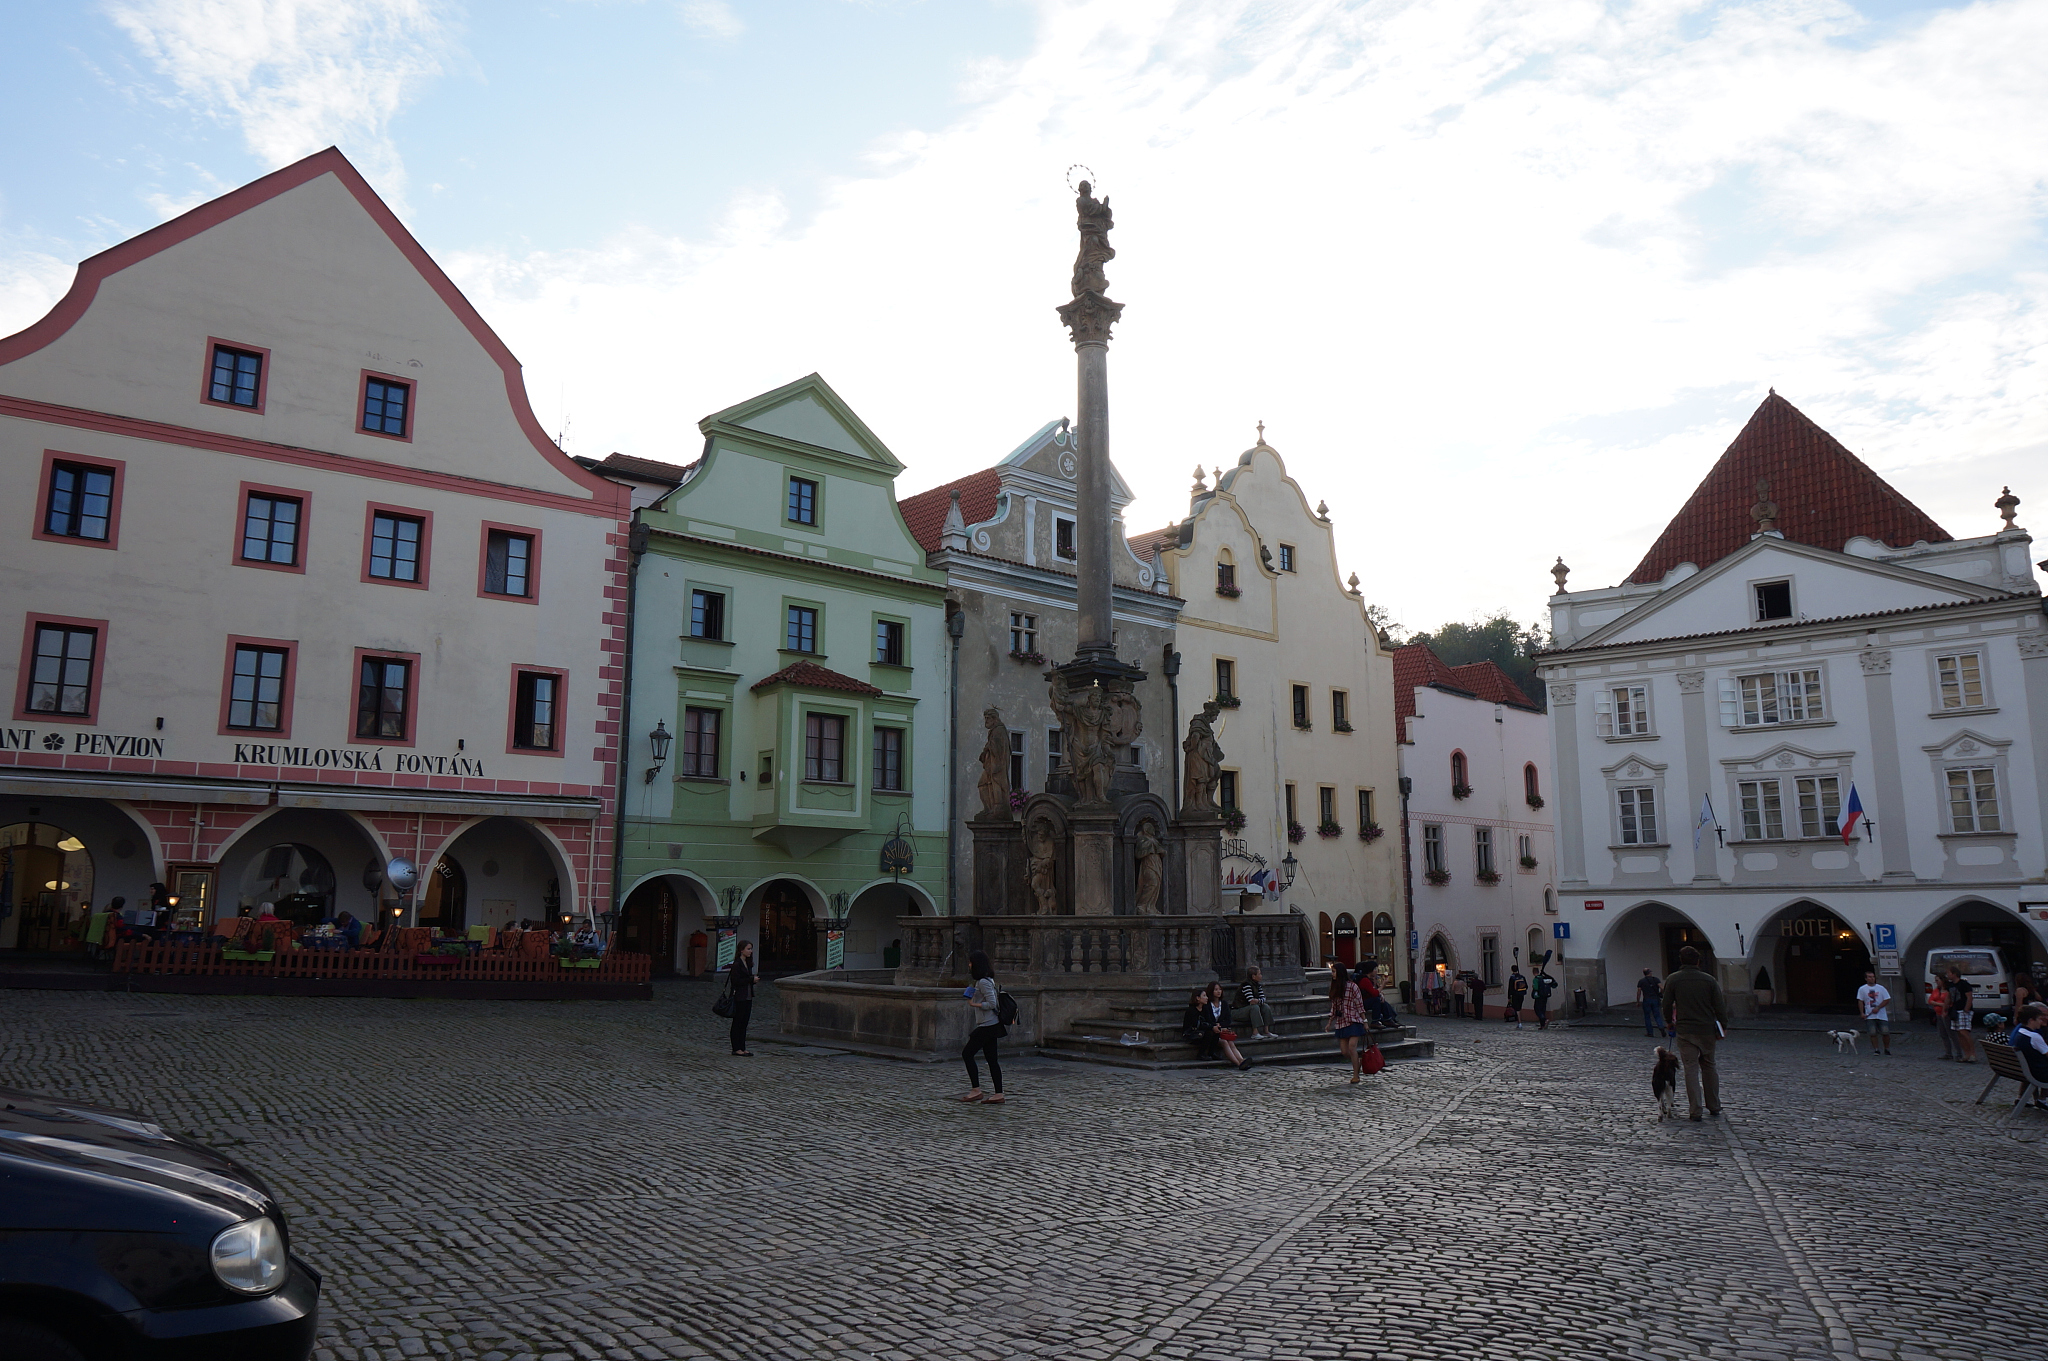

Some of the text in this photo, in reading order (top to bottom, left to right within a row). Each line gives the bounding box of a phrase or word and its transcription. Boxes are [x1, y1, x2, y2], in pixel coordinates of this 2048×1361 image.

[74, 732, 165, 758] PENZION
[233, 743, 485, 777] KRUMLOVSKÁ FONTÁNA
[1220, 838, 1250, 859] HOTEL
[1780, 919, 1838, 936] HOTEL
[1879, 927, 1892, 943] P
[1412, 932, 1417, 944] P
